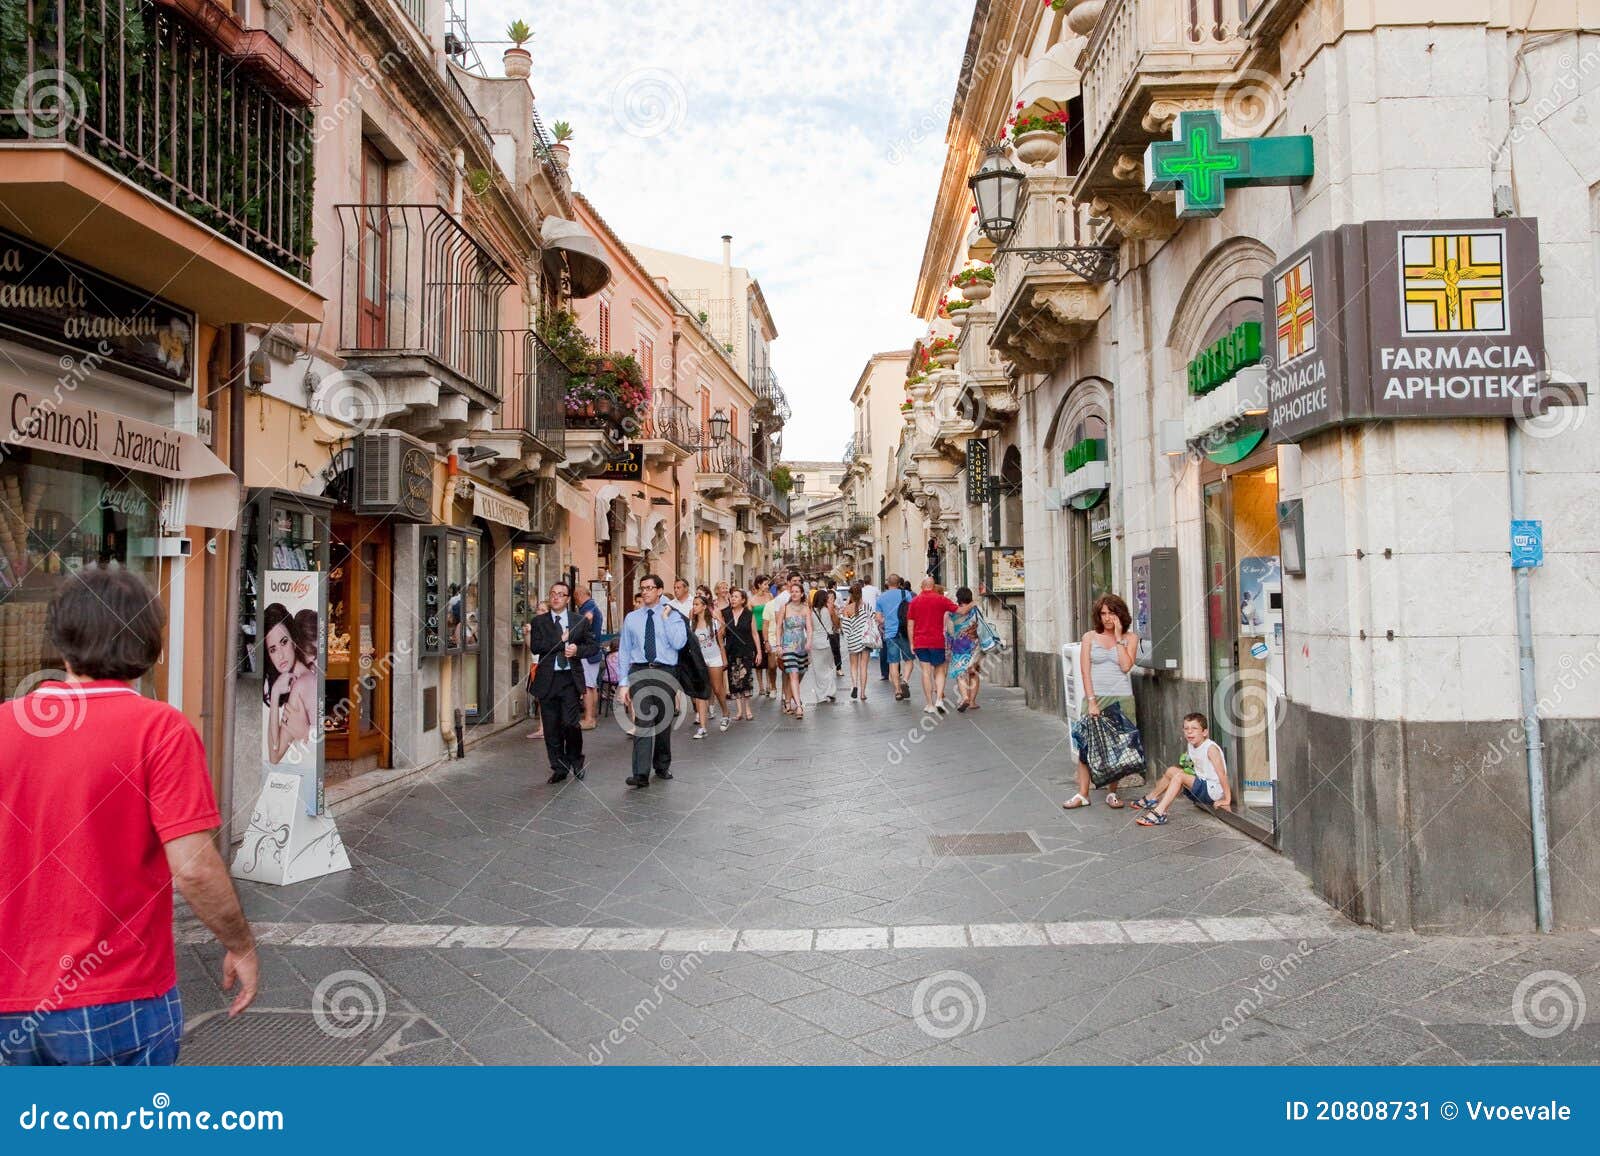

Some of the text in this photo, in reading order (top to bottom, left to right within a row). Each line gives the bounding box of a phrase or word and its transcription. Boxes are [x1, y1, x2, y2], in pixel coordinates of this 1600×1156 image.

[0, 274, 87, 308] annoli
[64, 308, 158, 339] arancini
[1188, 322, 1248, 396] BRITISH
[1381, 345, 1534, 371] FARMACIA
[1270, 359, 1326, 402] FARMACIA
[1384, 375, 1538, 400] APHOTEKE
[1272, 387, 1327, 428] APHOTEKE
[11, 392, 181, 471] Cannoli Arancini
[607, 463, 639, 472] ETTO
